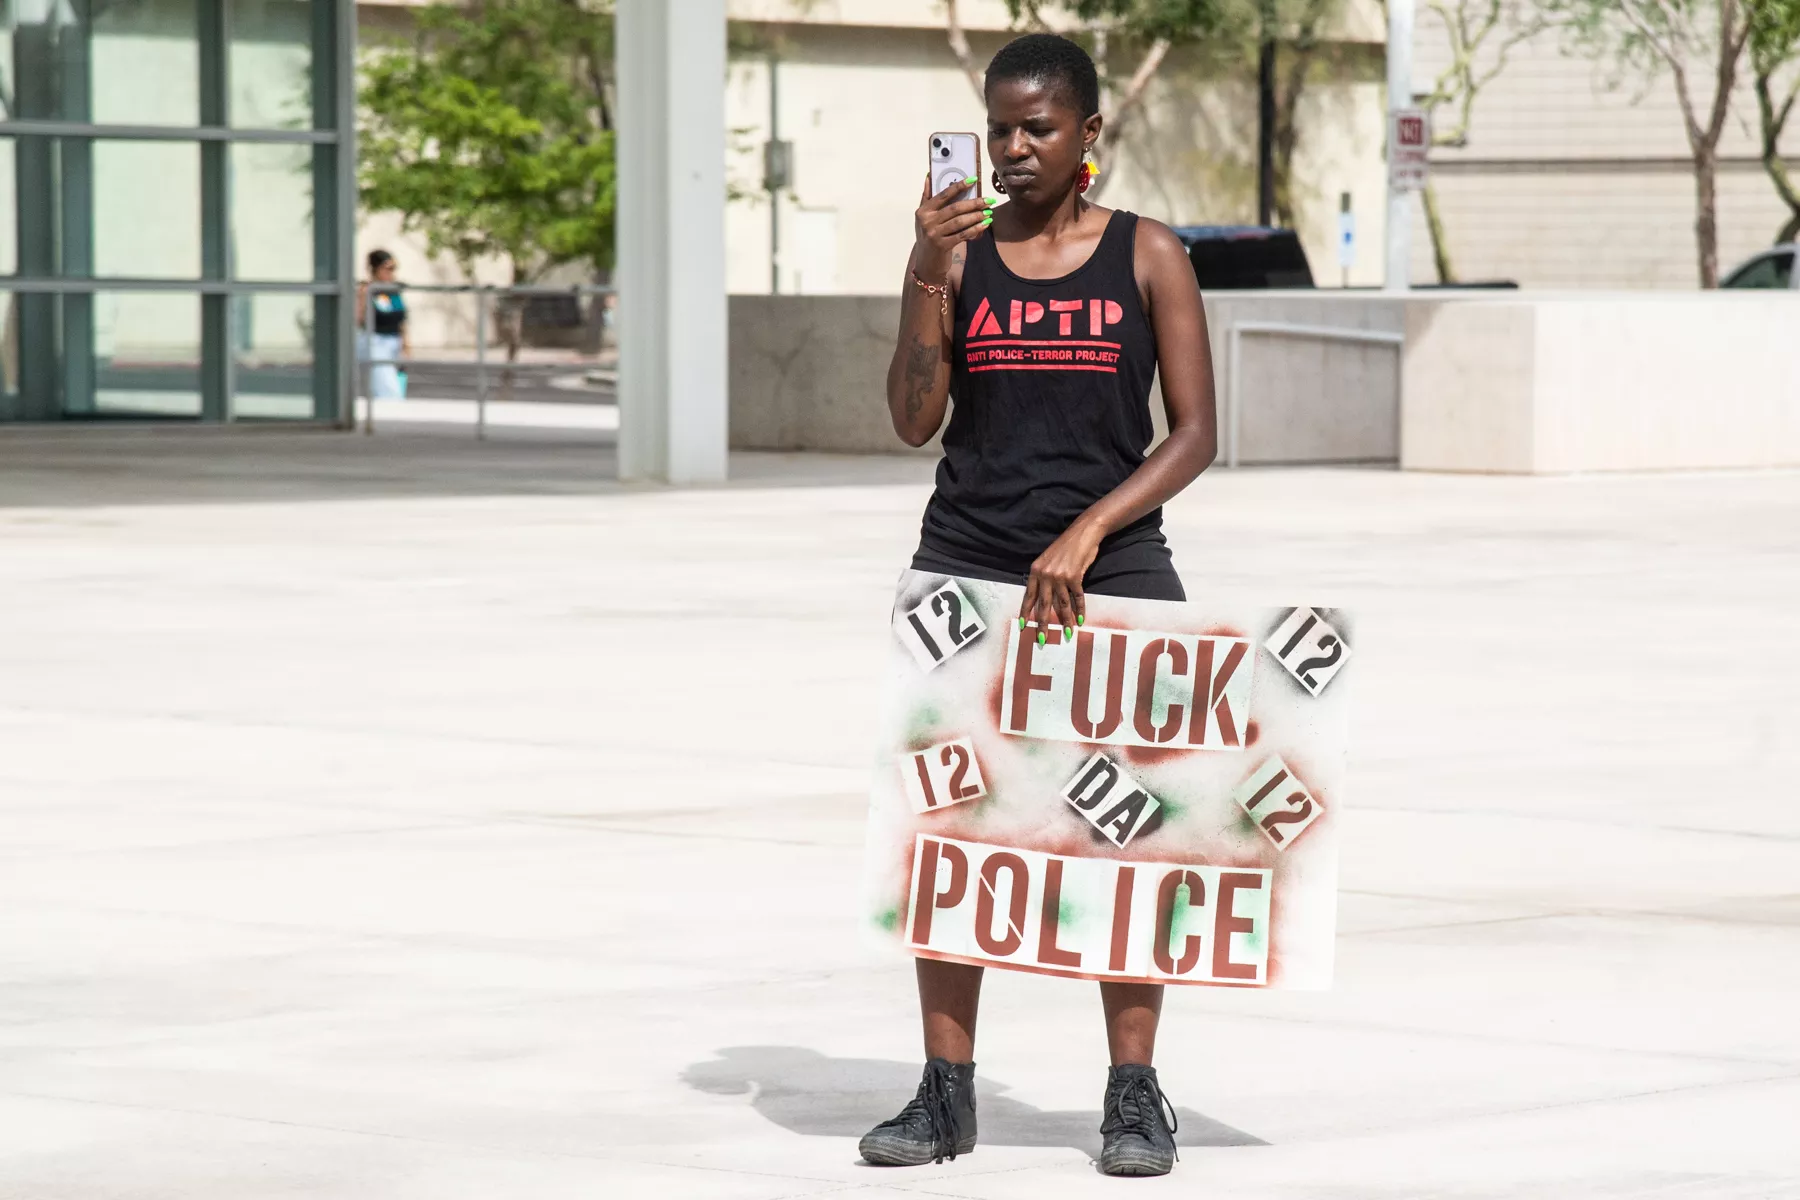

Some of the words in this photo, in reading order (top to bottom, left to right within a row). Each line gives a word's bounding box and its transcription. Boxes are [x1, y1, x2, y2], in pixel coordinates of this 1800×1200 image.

[966, 297, 1123, 338] APTP
[966, 351, 987, 363] ANTI
[1075, 350, 1120, 363] PROJECT
[907, 590, 979, 662] 12
[1277, 613, 1343, 689] 12
[1009, 625, 1250, 747] FUCK
[913, 744, 980, 808] 12
[1068, 757, 1149, 845] DA
[1245, 769, 1314, 844] 12
[911, 840, 1264, 980] POLICE
